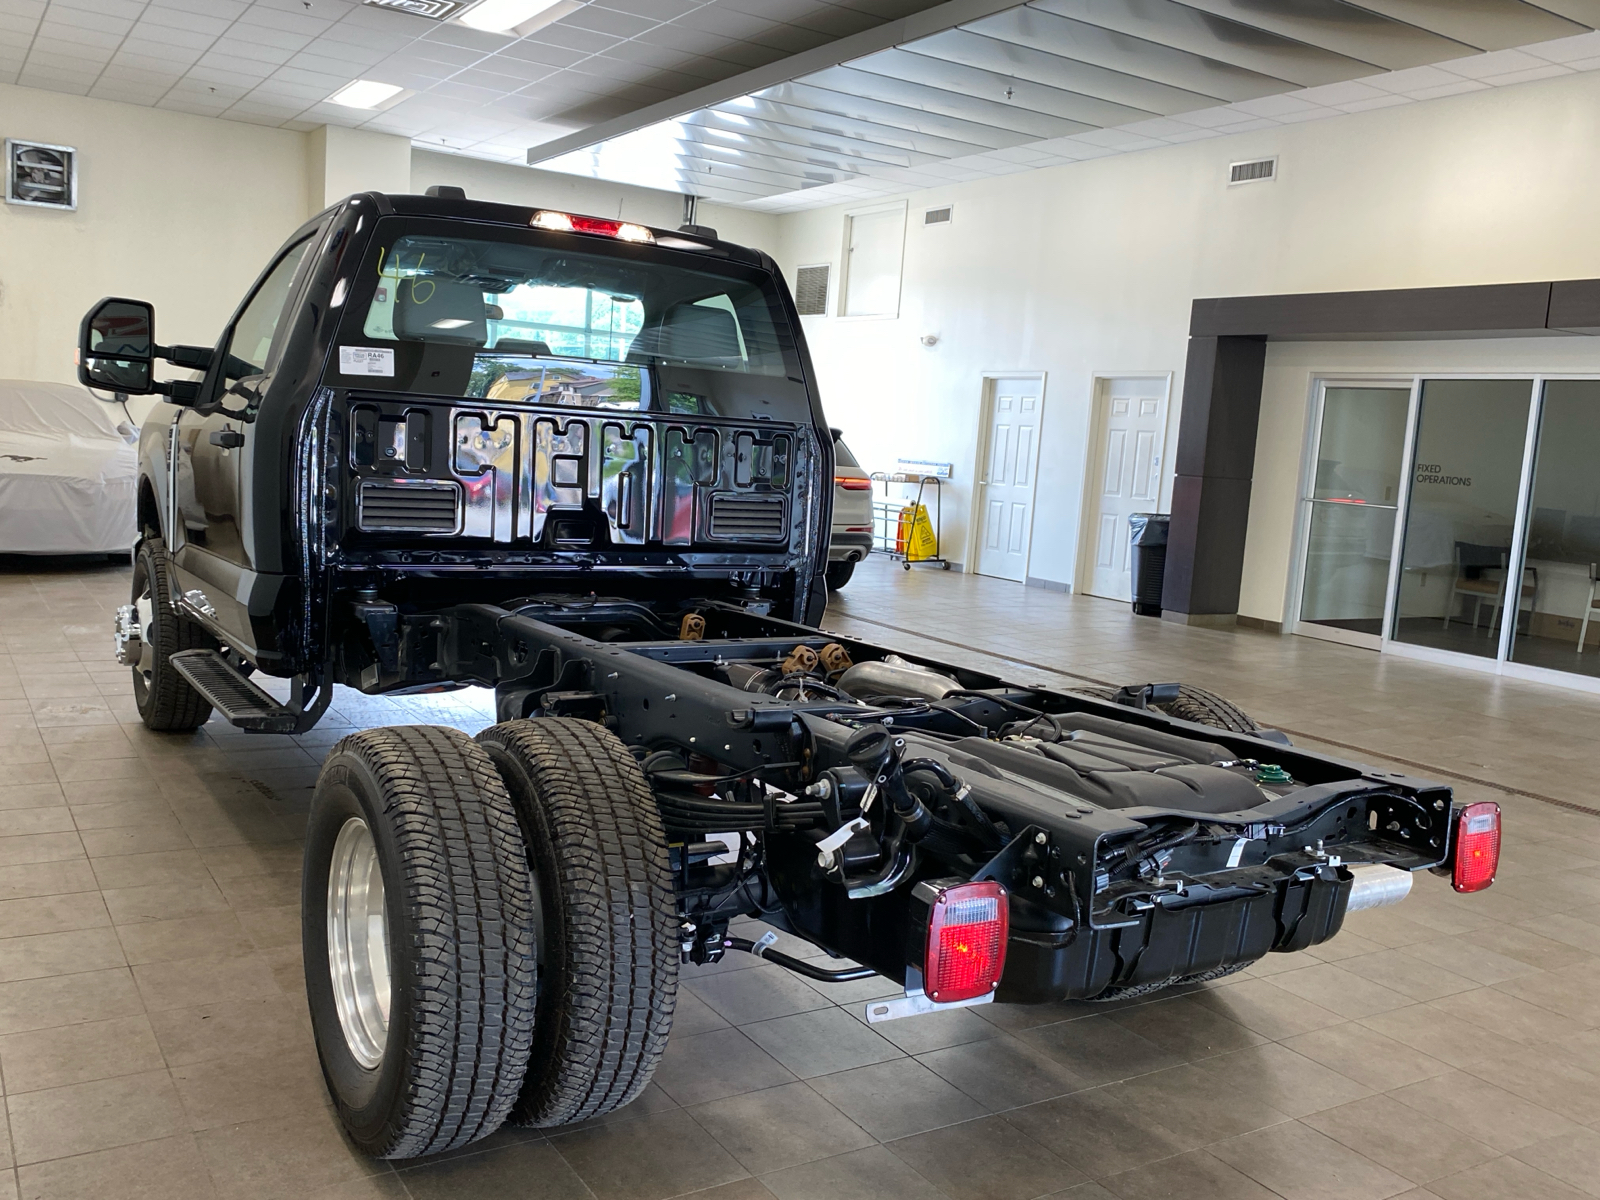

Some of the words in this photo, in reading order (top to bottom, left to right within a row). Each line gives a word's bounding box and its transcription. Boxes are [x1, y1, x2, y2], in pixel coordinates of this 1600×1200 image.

[377, 246, 436, 305] 46
[1417, 463, 1442, 474] FIXED
[1416, 474, 1472, 487] OPERATIONS
